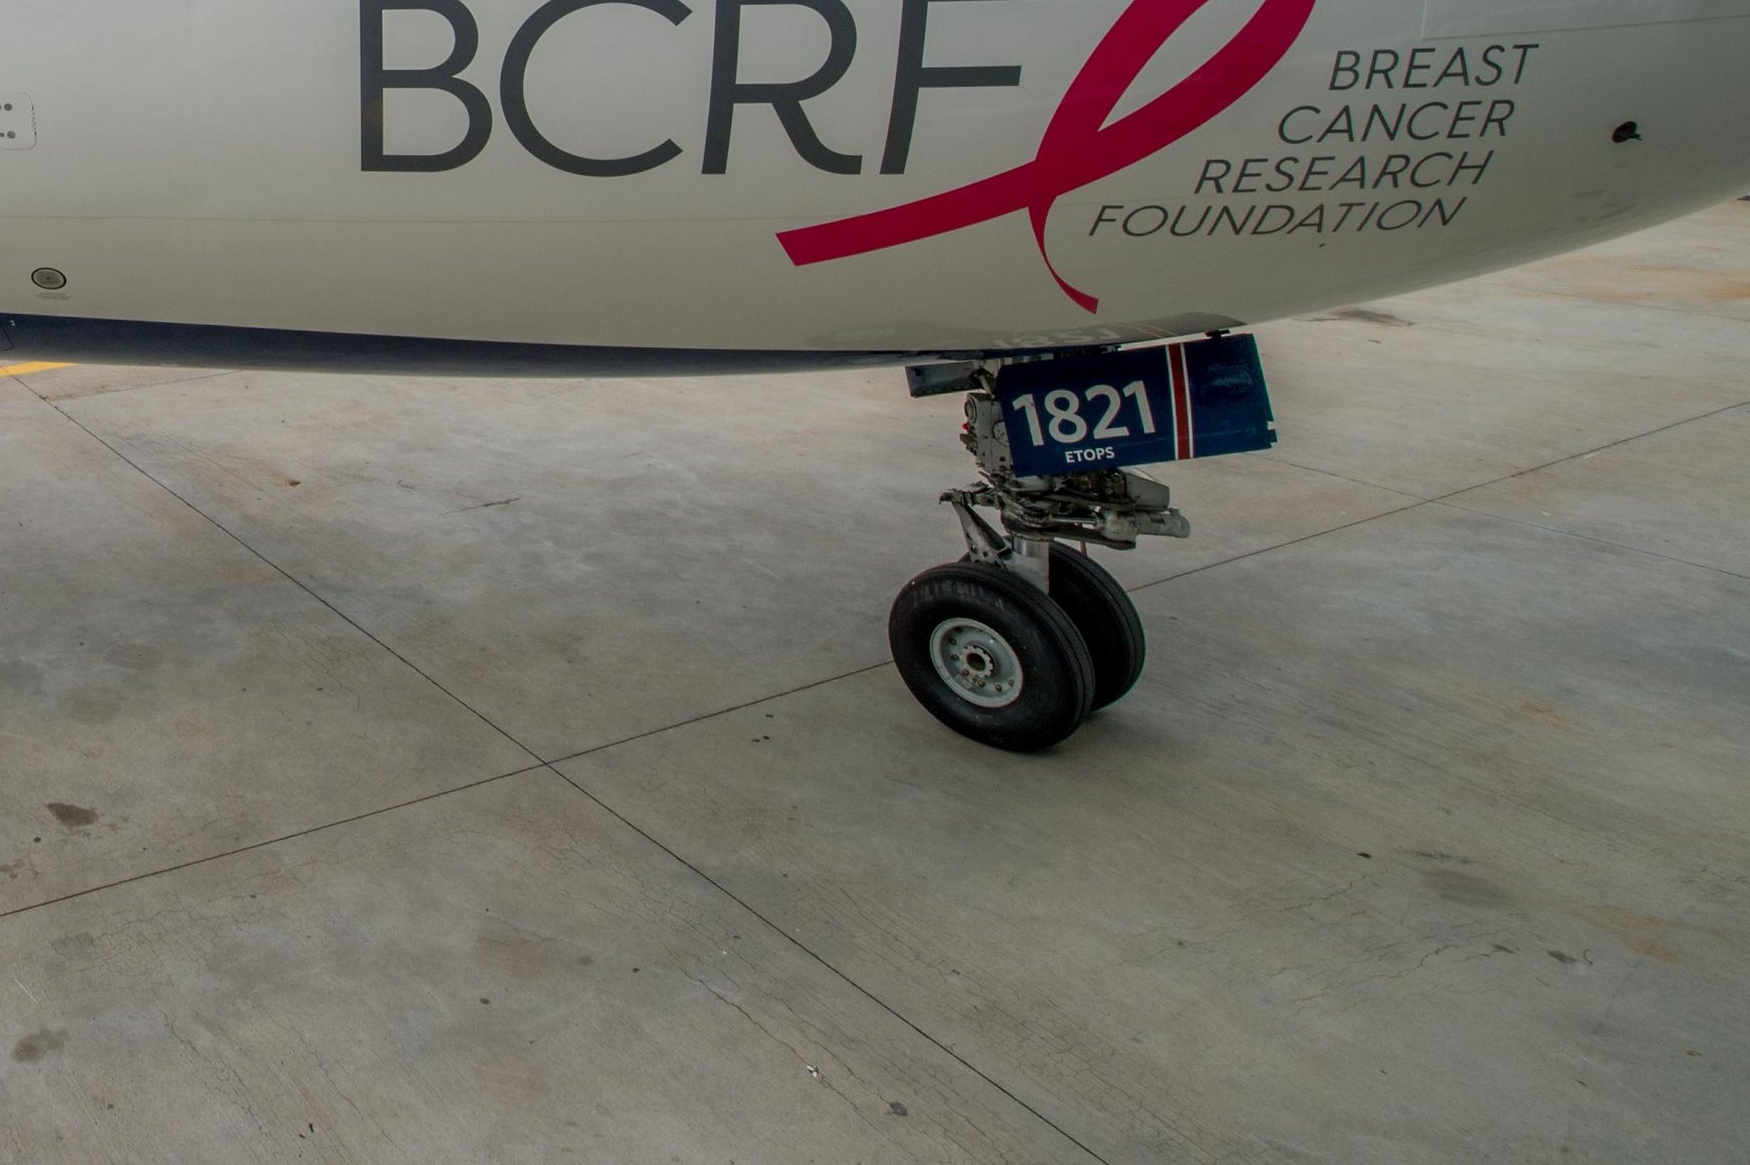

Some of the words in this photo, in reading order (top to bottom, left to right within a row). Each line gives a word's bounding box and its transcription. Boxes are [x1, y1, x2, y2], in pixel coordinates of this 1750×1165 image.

[1328, 43, 1540, 91] BREAST
[1277, 98, 1516, 145] CANCER
[1193, 149, 1495, 195] RESEARCH
[1088, 195, 1469, 238] FOUNDATION
[1012, 380, 1156, 447] 1821
[1064, 446, 1116, 464] ETOPS
